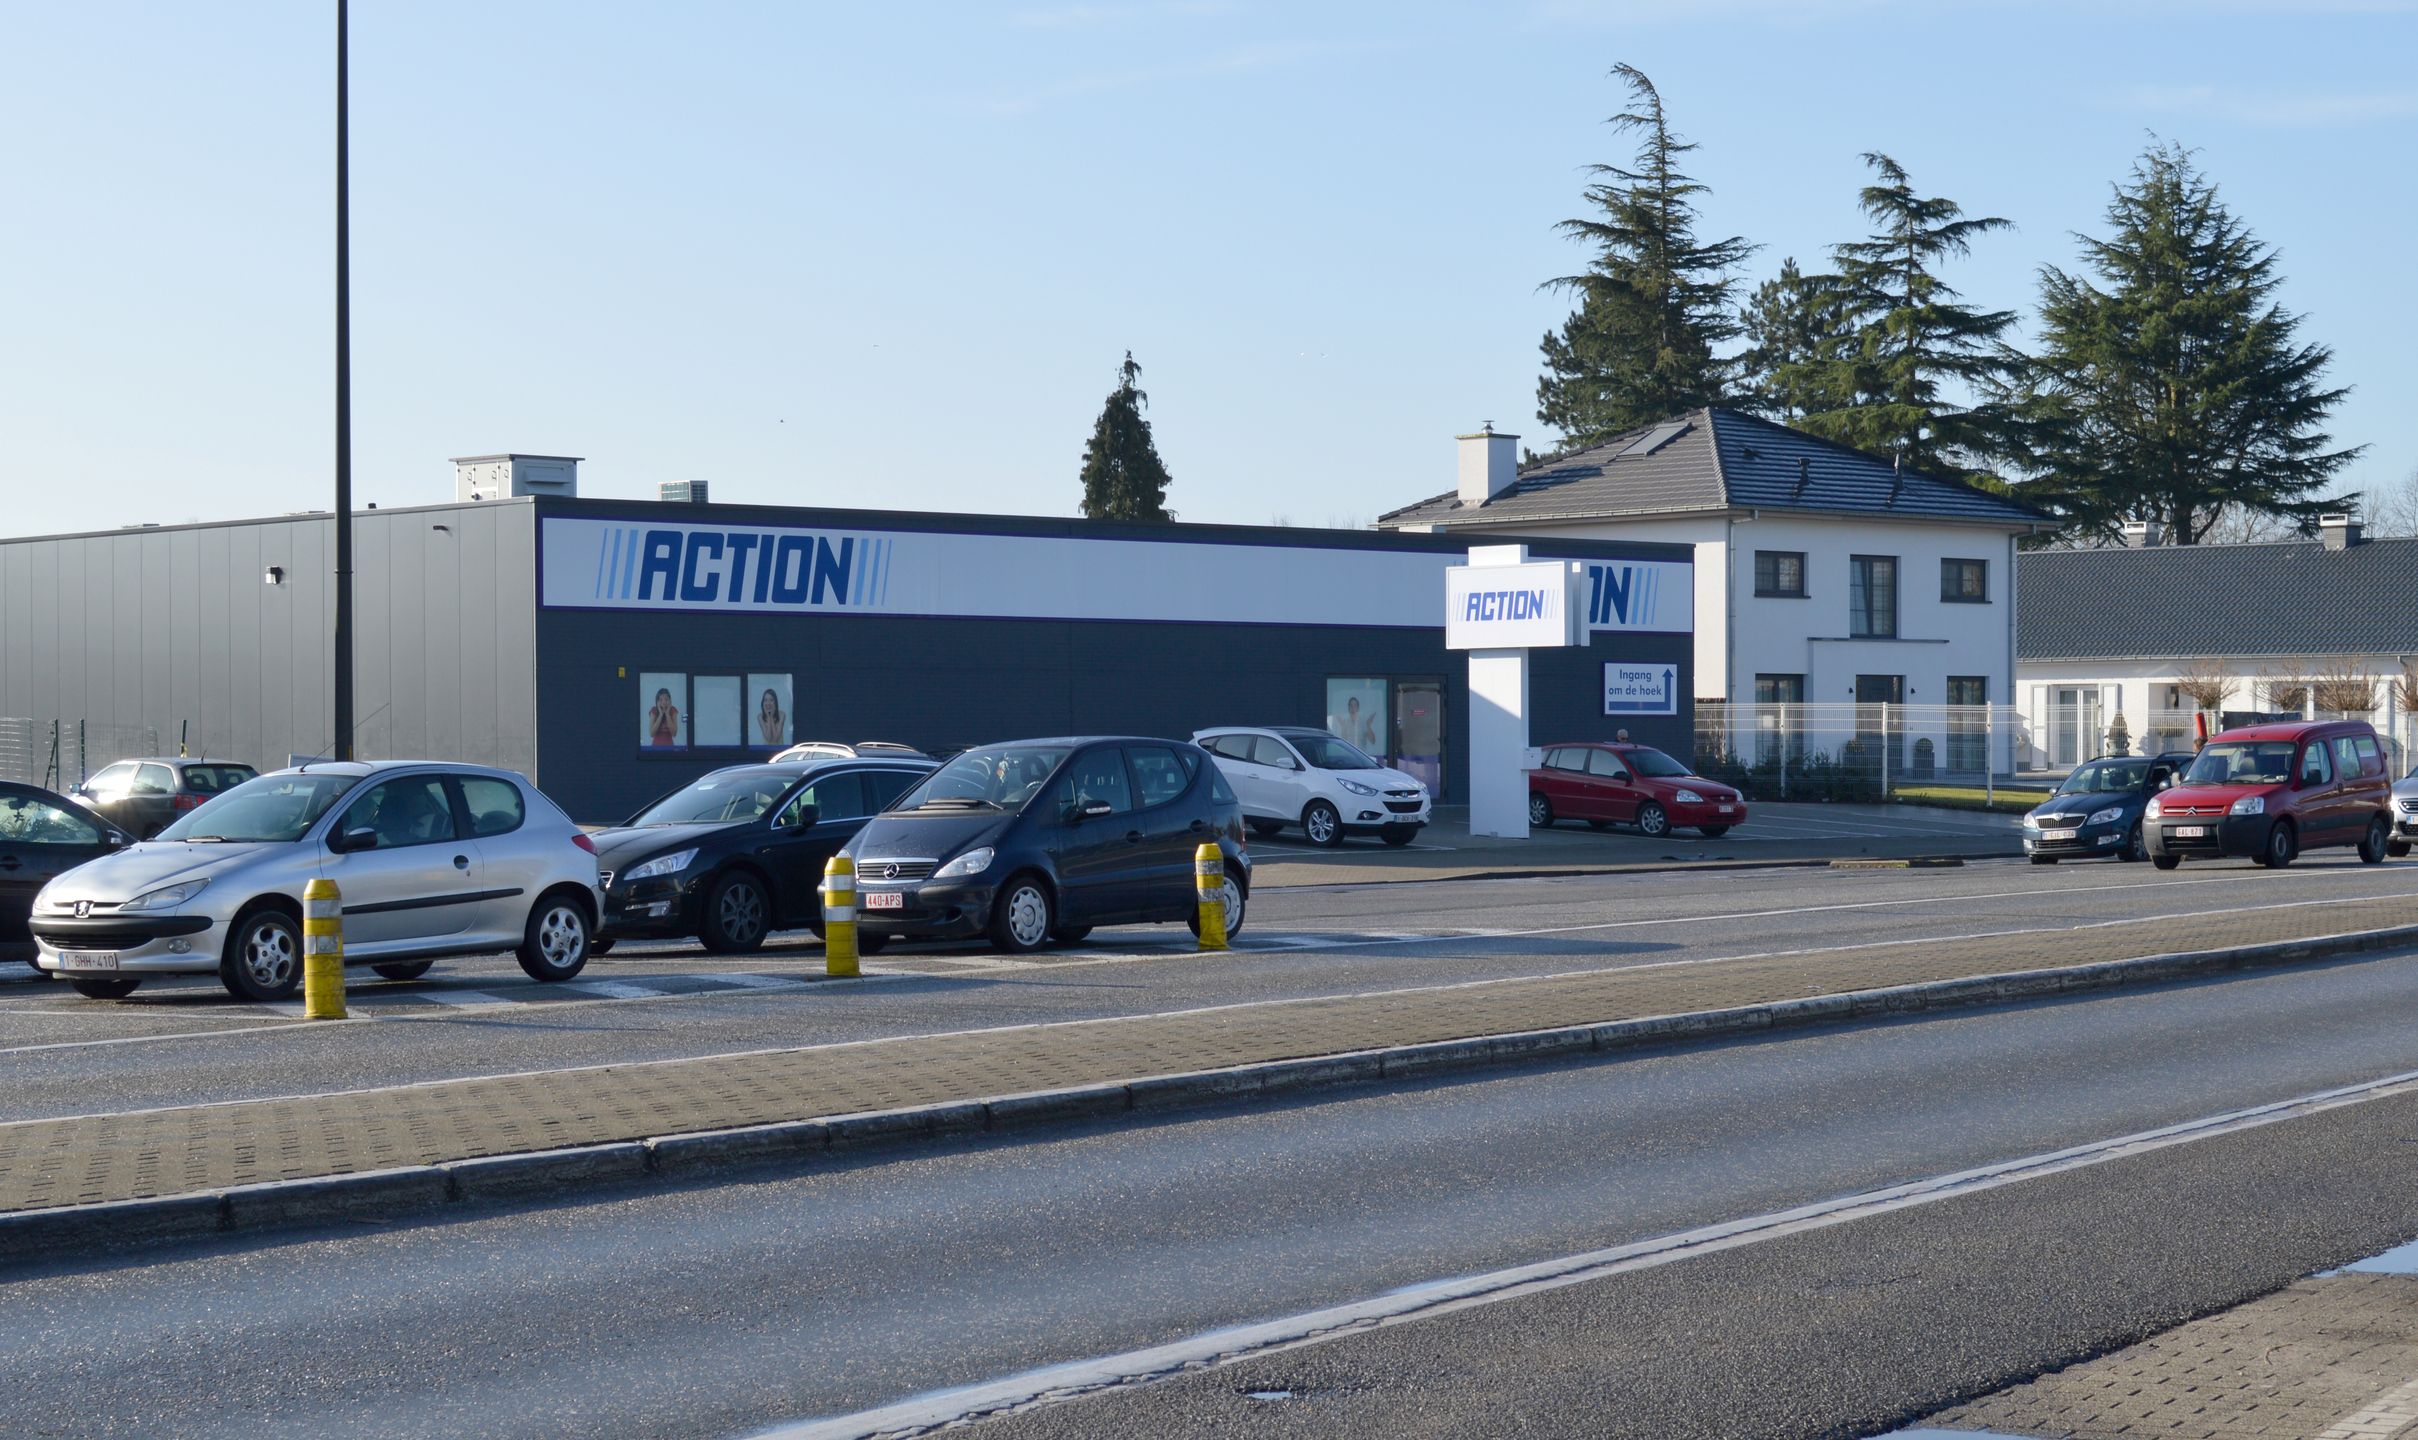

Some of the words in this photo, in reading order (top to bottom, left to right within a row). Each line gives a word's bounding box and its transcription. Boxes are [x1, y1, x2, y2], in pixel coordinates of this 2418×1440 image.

[637, 530, 854, 605] ACTION
[1466, 589, 1545, 621] ACTION
[1619, 669, 1652, 682] Ingang
[1608, 687, 1622, 695] om
[1625, 685, 1637, 695] de
[1639, 685, 1662, 695] hoek
[868, 895, 901, 906] 440-APS
[65, 955, 115, 968] 1-GHH-410
